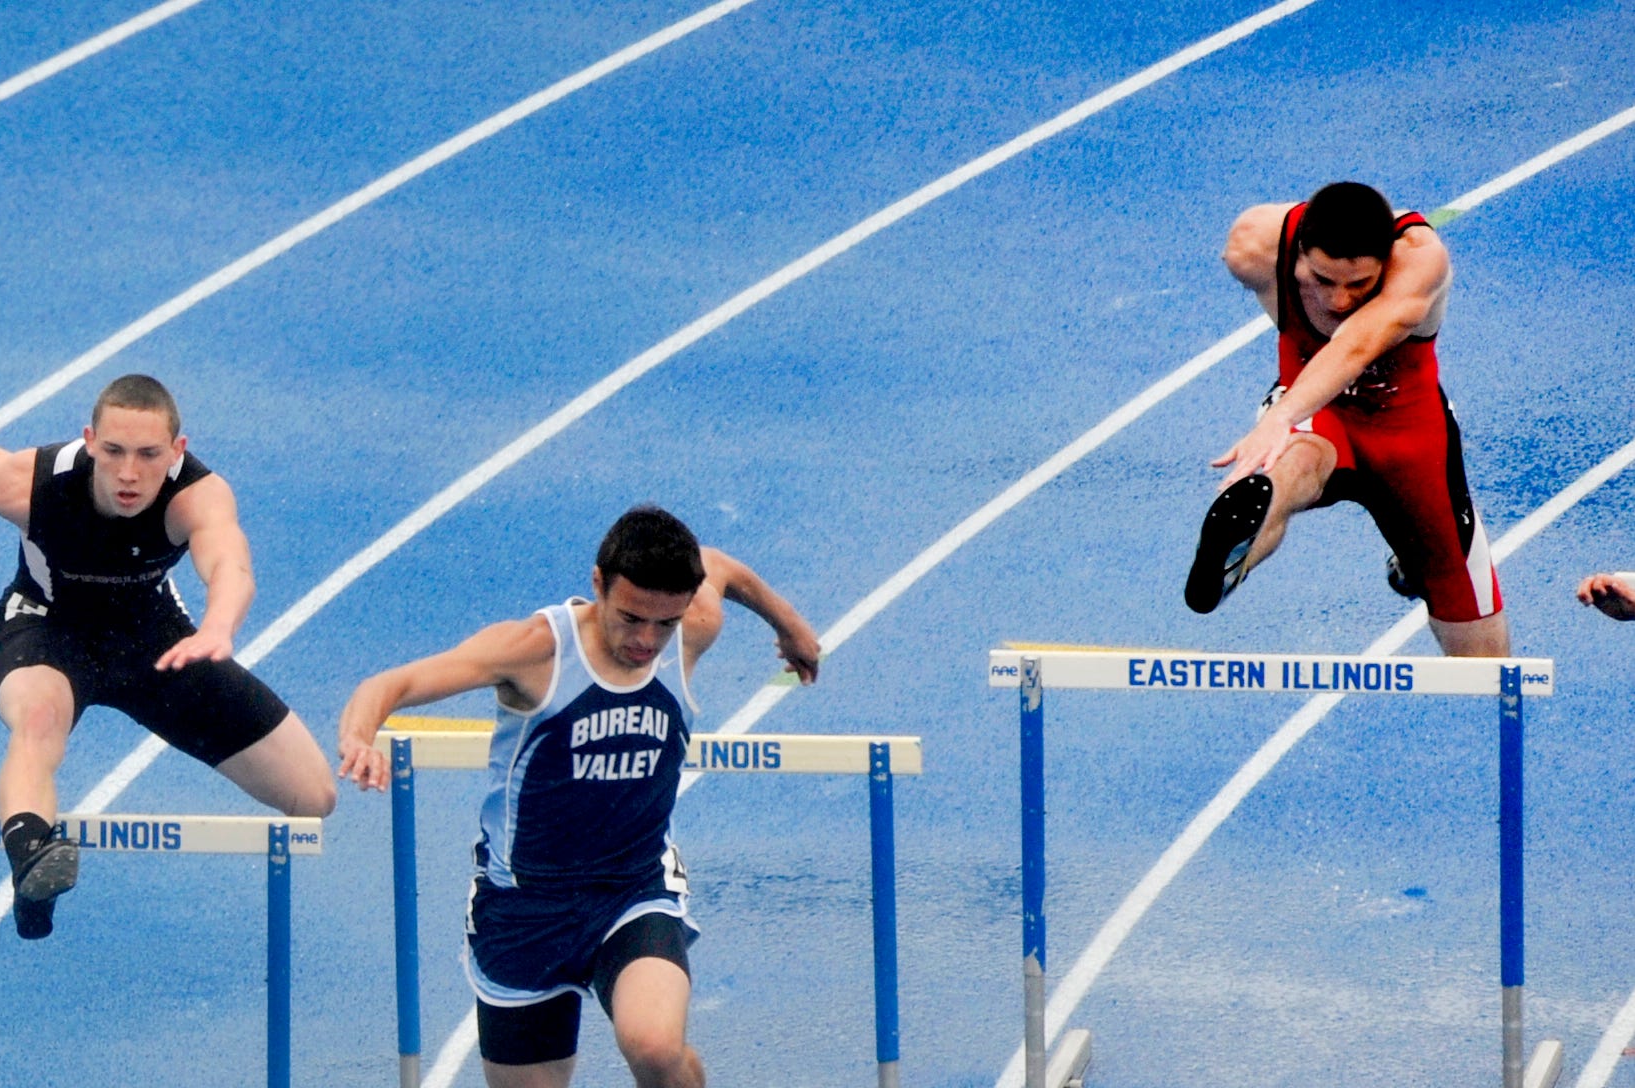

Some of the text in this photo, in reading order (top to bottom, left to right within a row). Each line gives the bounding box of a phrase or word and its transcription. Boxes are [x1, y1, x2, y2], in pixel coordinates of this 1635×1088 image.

[1128, 658, 1414, 692] EASTERN ILLINOIS
[570, 705, 669, 749] BUREAU
[572, 748, 662, 781] VALLEY
[683, 740, 781, 769] INOIS
